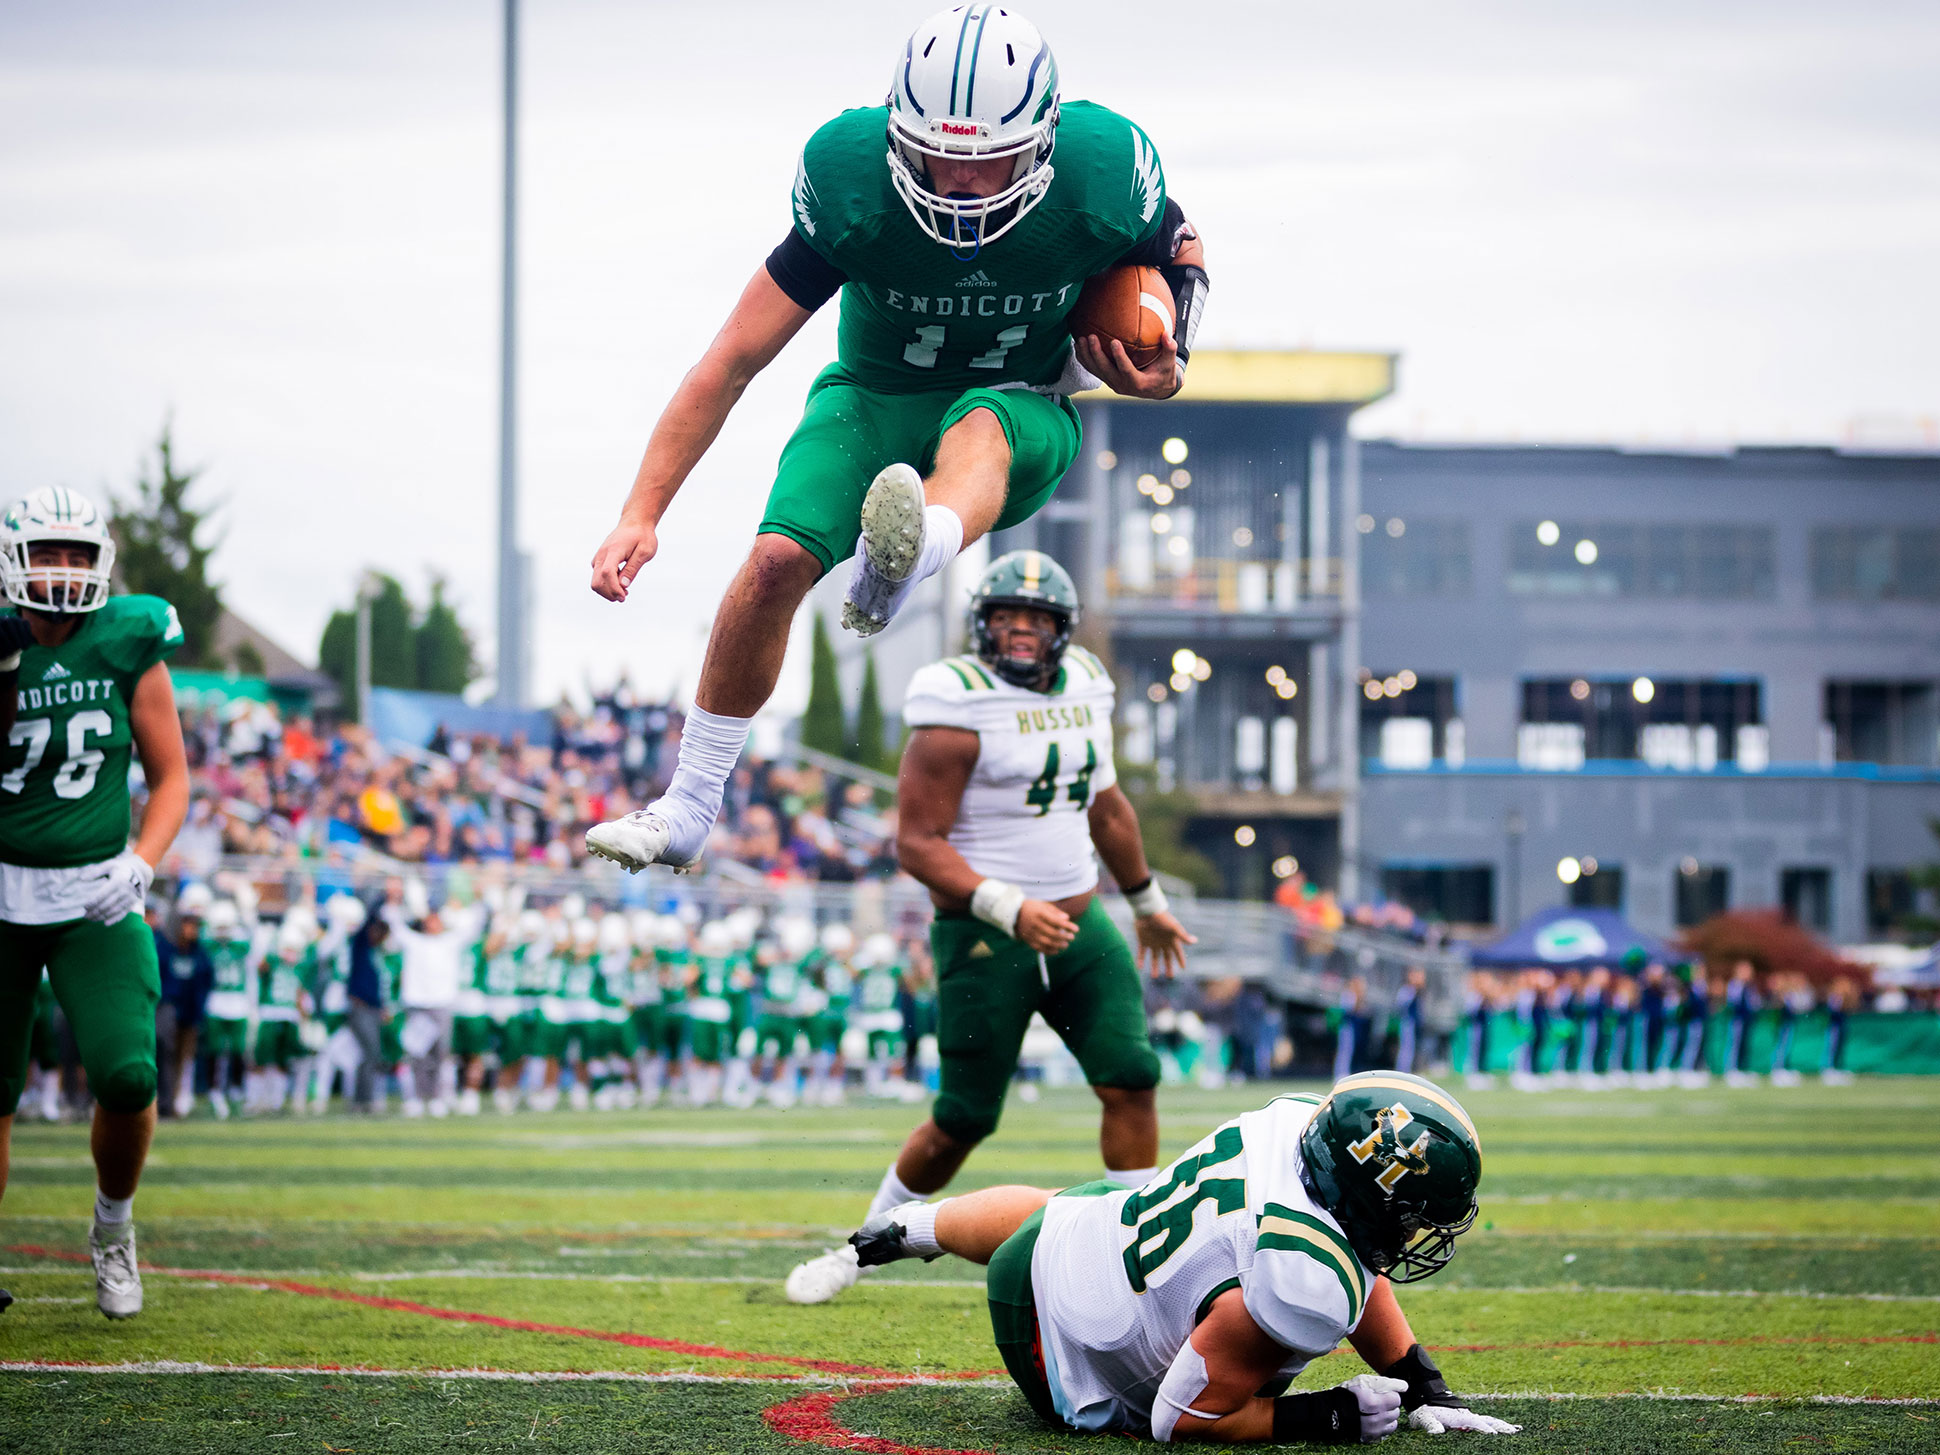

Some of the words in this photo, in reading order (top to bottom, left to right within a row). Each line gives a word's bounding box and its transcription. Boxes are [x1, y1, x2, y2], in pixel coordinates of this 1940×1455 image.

[942, 122, 977, 136] Riddell
[886, 283, 1073, 316] ENDICOTT
[955, 280, 998, 288] adidas
[903, 325, 1029, 369] 11
[17, 679, 114, 711] NDICOTT
[1, 709, 112, 799] 76
[1025, 738, 1097, 818] 44
